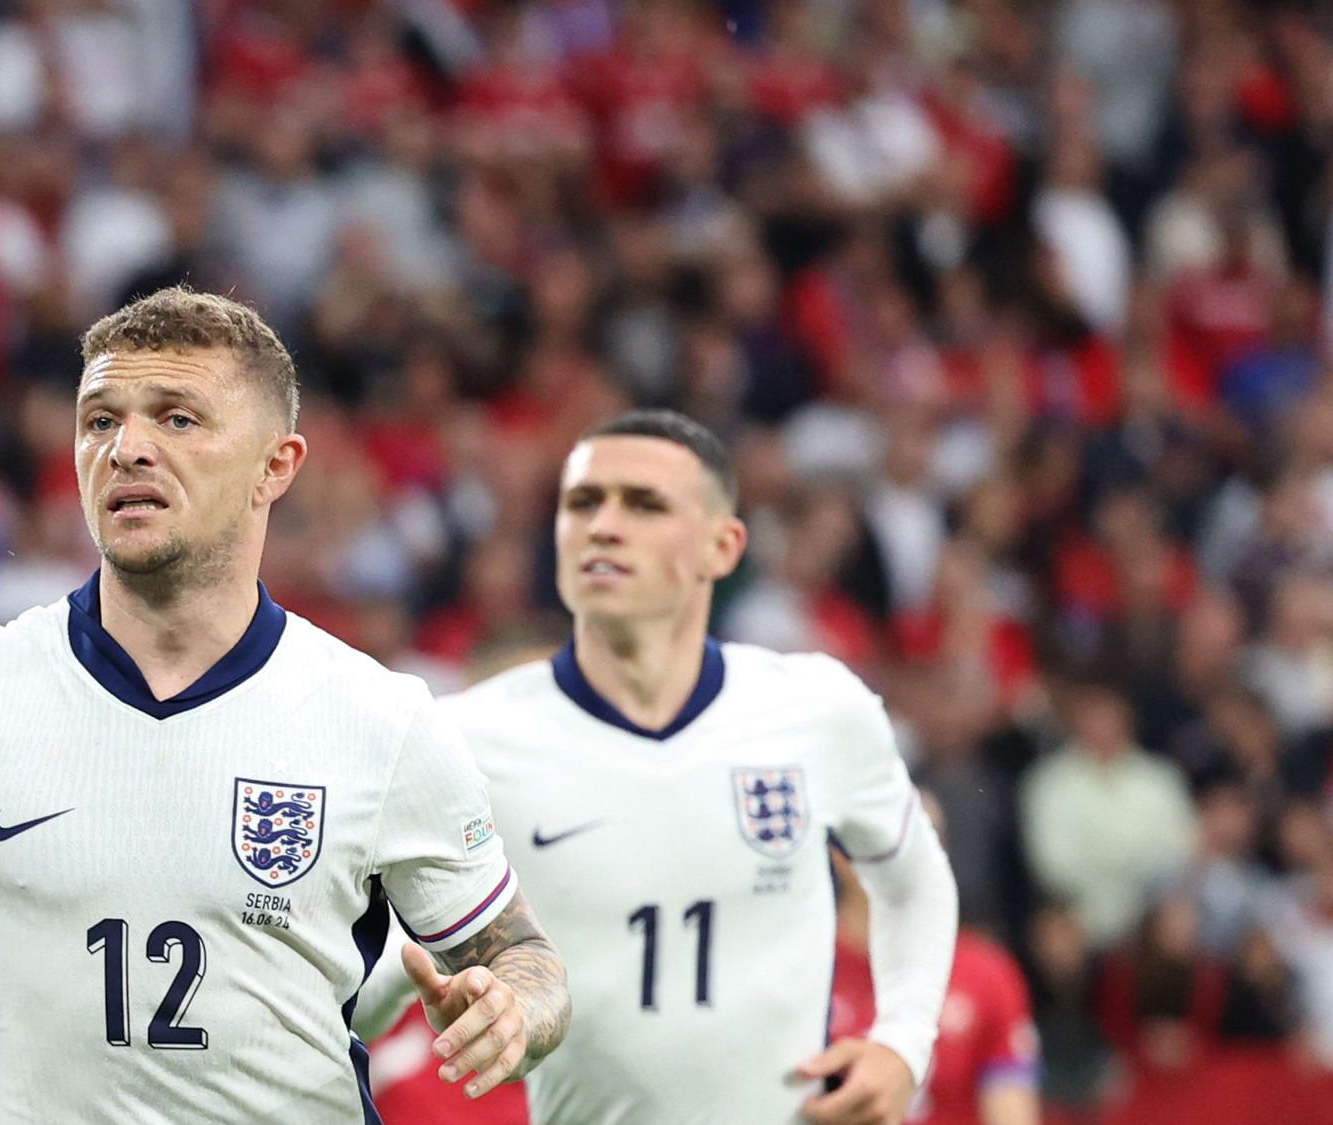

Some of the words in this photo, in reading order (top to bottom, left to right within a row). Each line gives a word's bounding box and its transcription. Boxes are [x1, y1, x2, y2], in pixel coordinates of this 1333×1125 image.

[245, 892, 291, 912] SERBIA
[627, 900, 715, 1013] 11
[87, 918, 208, 1049] 12
